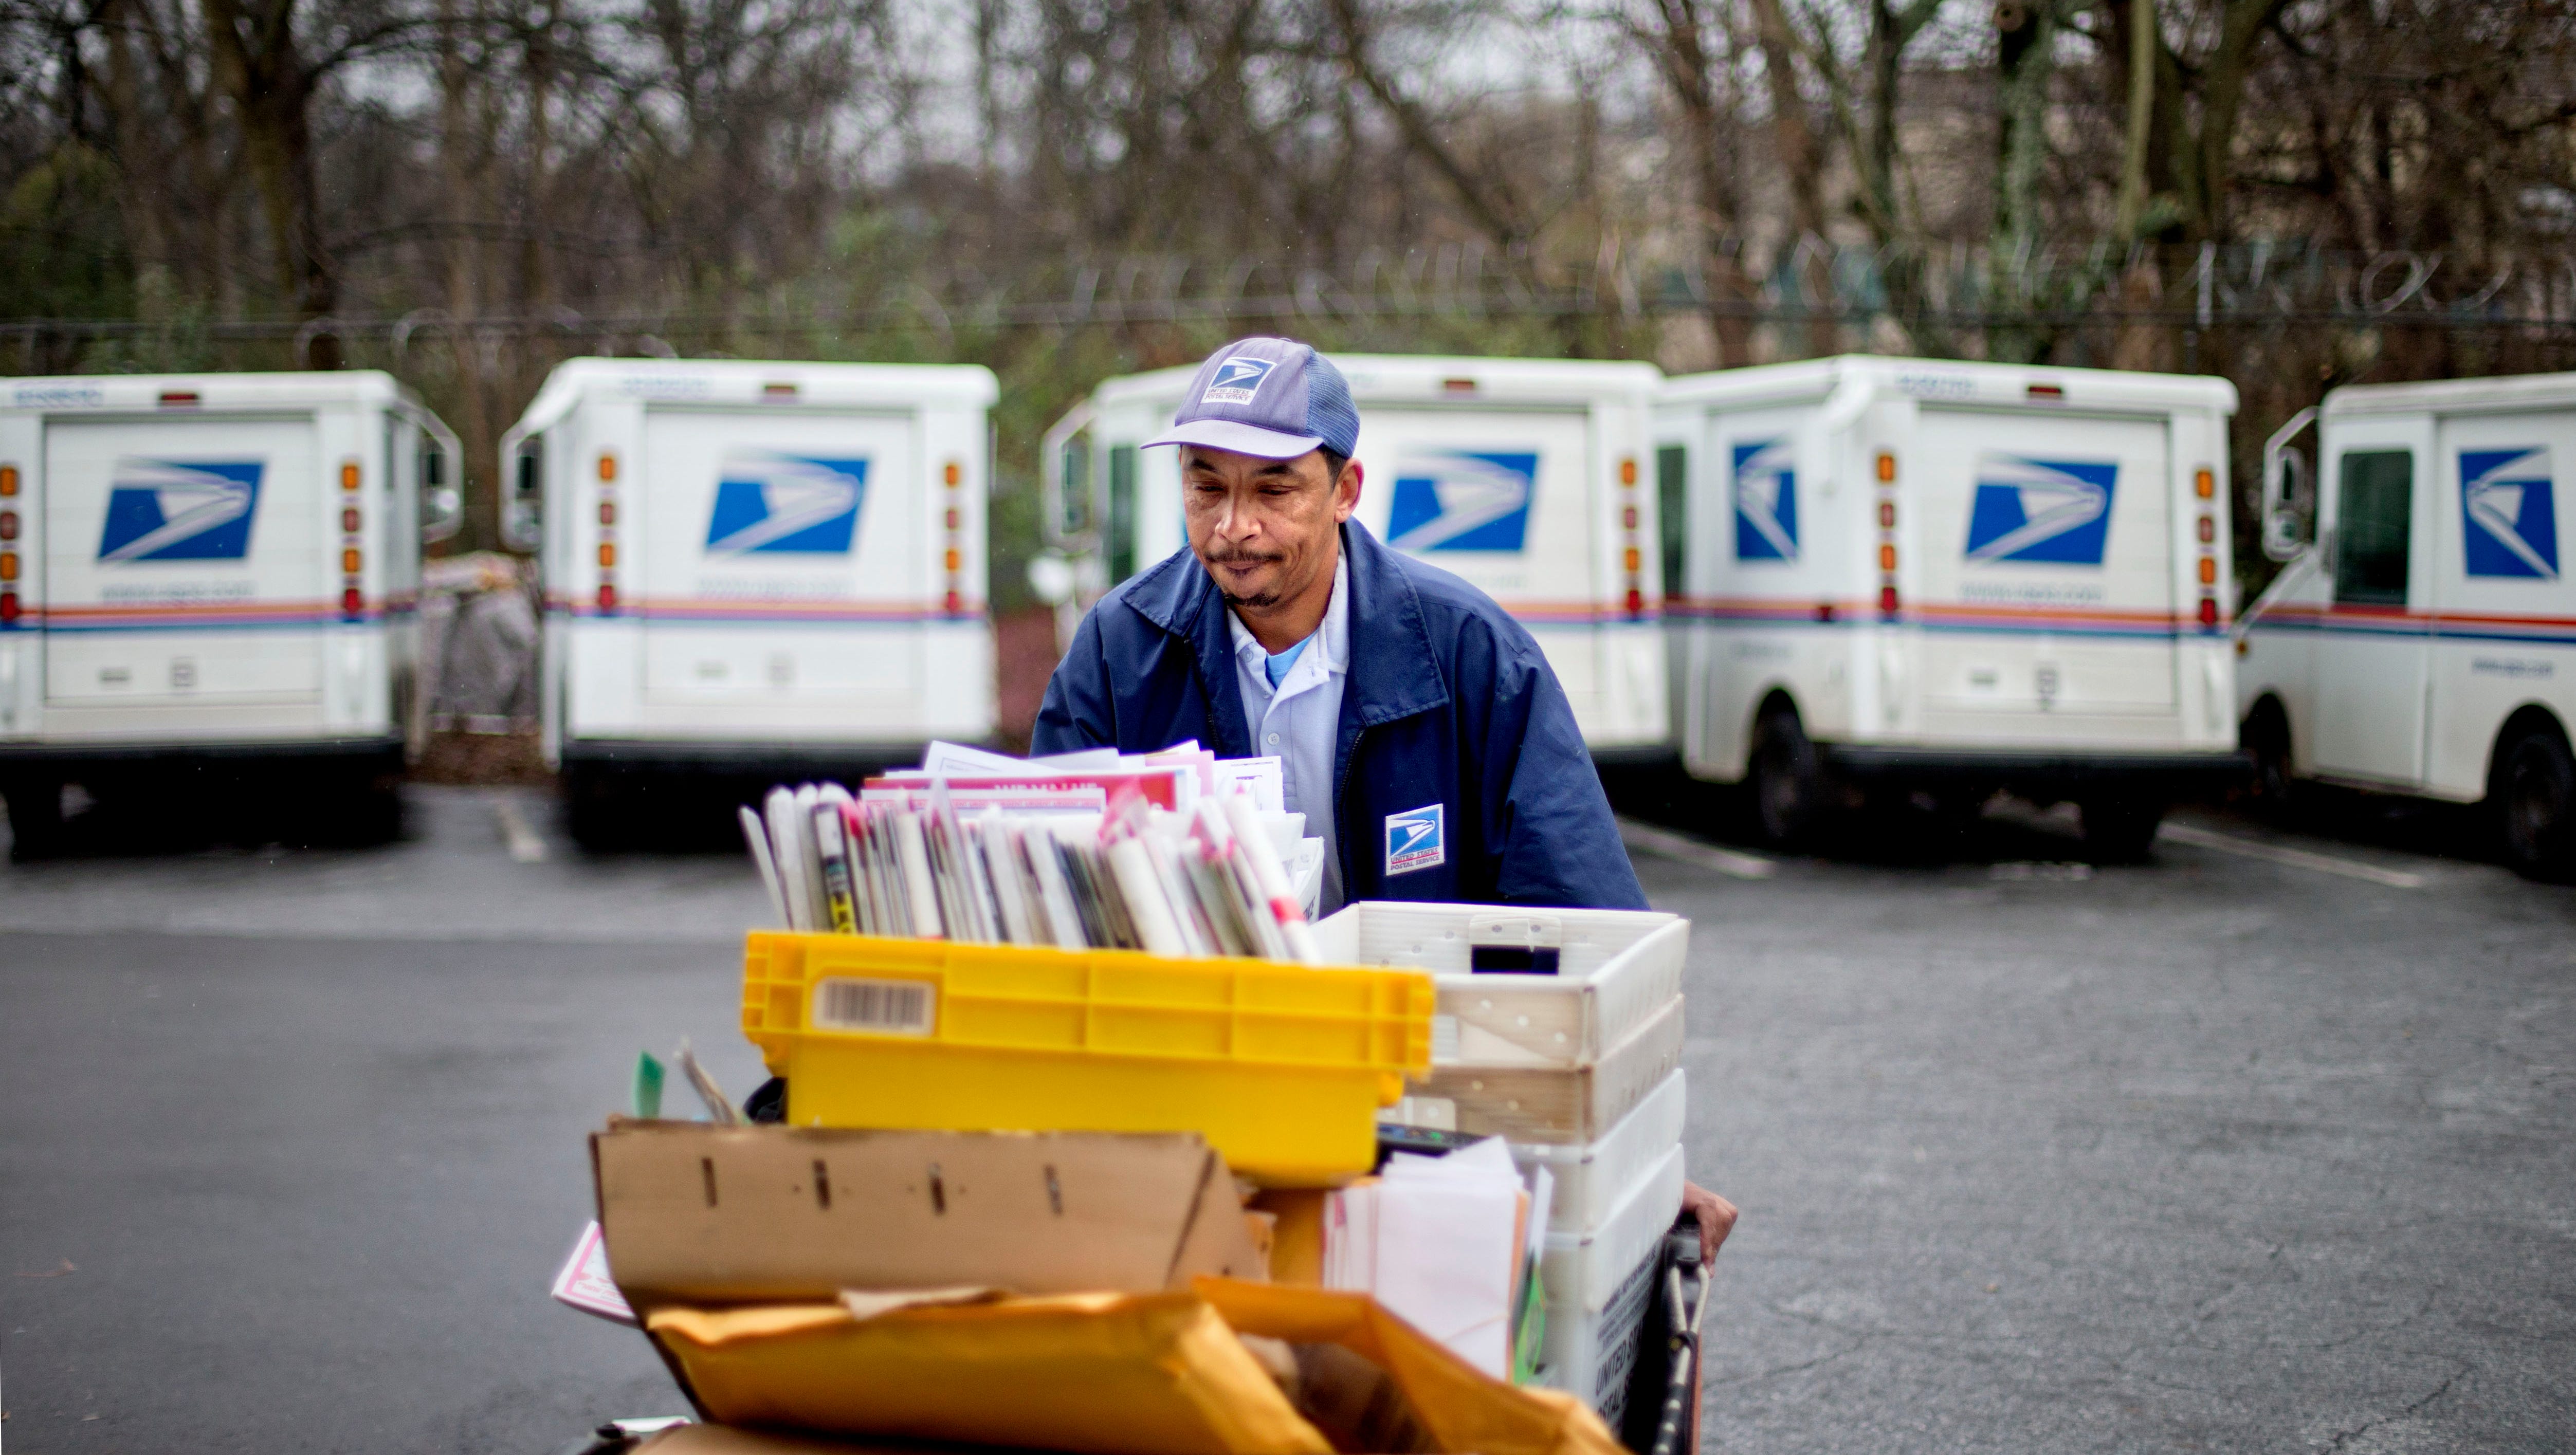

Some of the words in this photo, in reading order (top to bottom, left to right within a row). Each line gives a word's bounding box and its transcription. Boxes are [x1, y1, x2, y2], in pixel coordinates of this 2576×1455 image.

[1391, 854, 1414, 862] UNITED
[1417, 848, 1438, 857] STATES
[1391, 861, 1414, 870] POSTAL
[1416, 855, 1439, 864] SERVICE
[1596, 1339, 1626, 1396] UNITED
[1597, 1383, 1620, 1424] OSTAL
